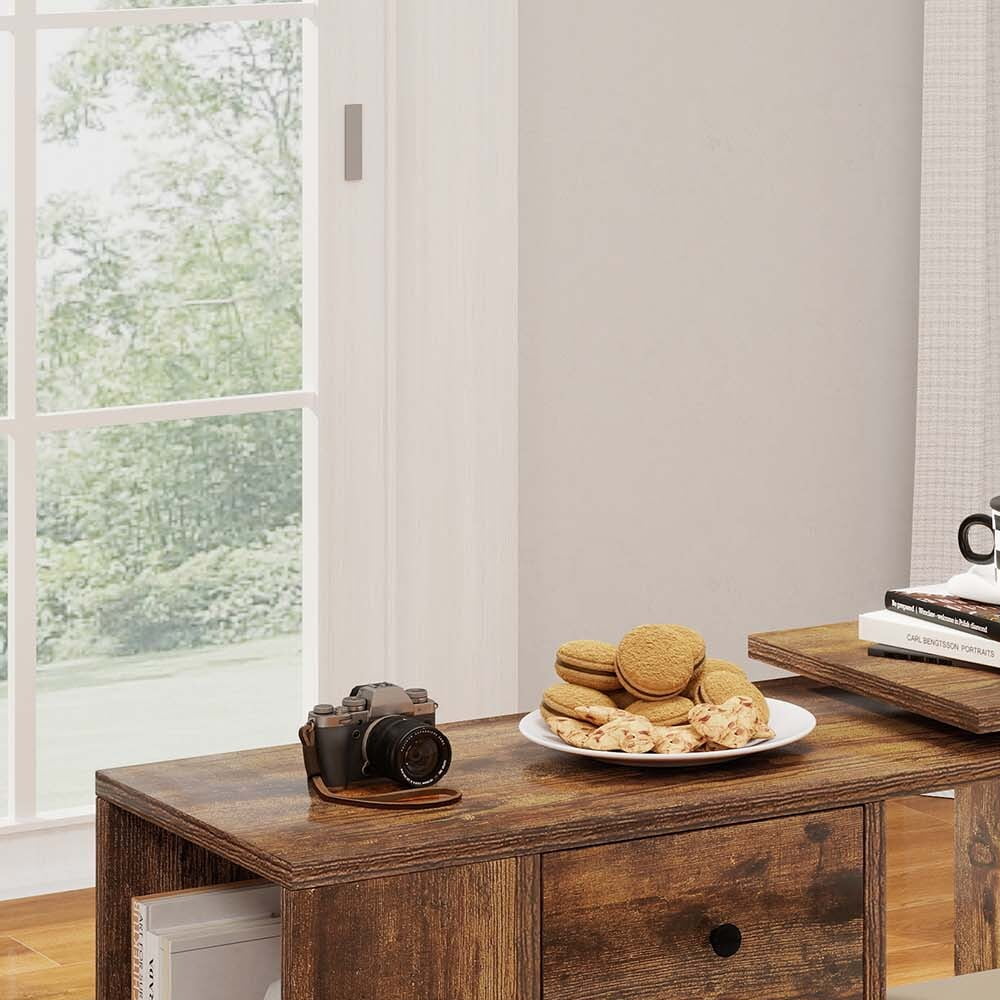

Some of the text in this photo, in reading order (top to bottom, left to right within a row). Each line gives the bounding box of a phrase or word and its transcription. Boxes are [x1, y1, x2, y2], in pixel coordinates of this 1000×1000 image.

[906, 633, 995, 658] CARL BENGTSSON PORTRAITS
